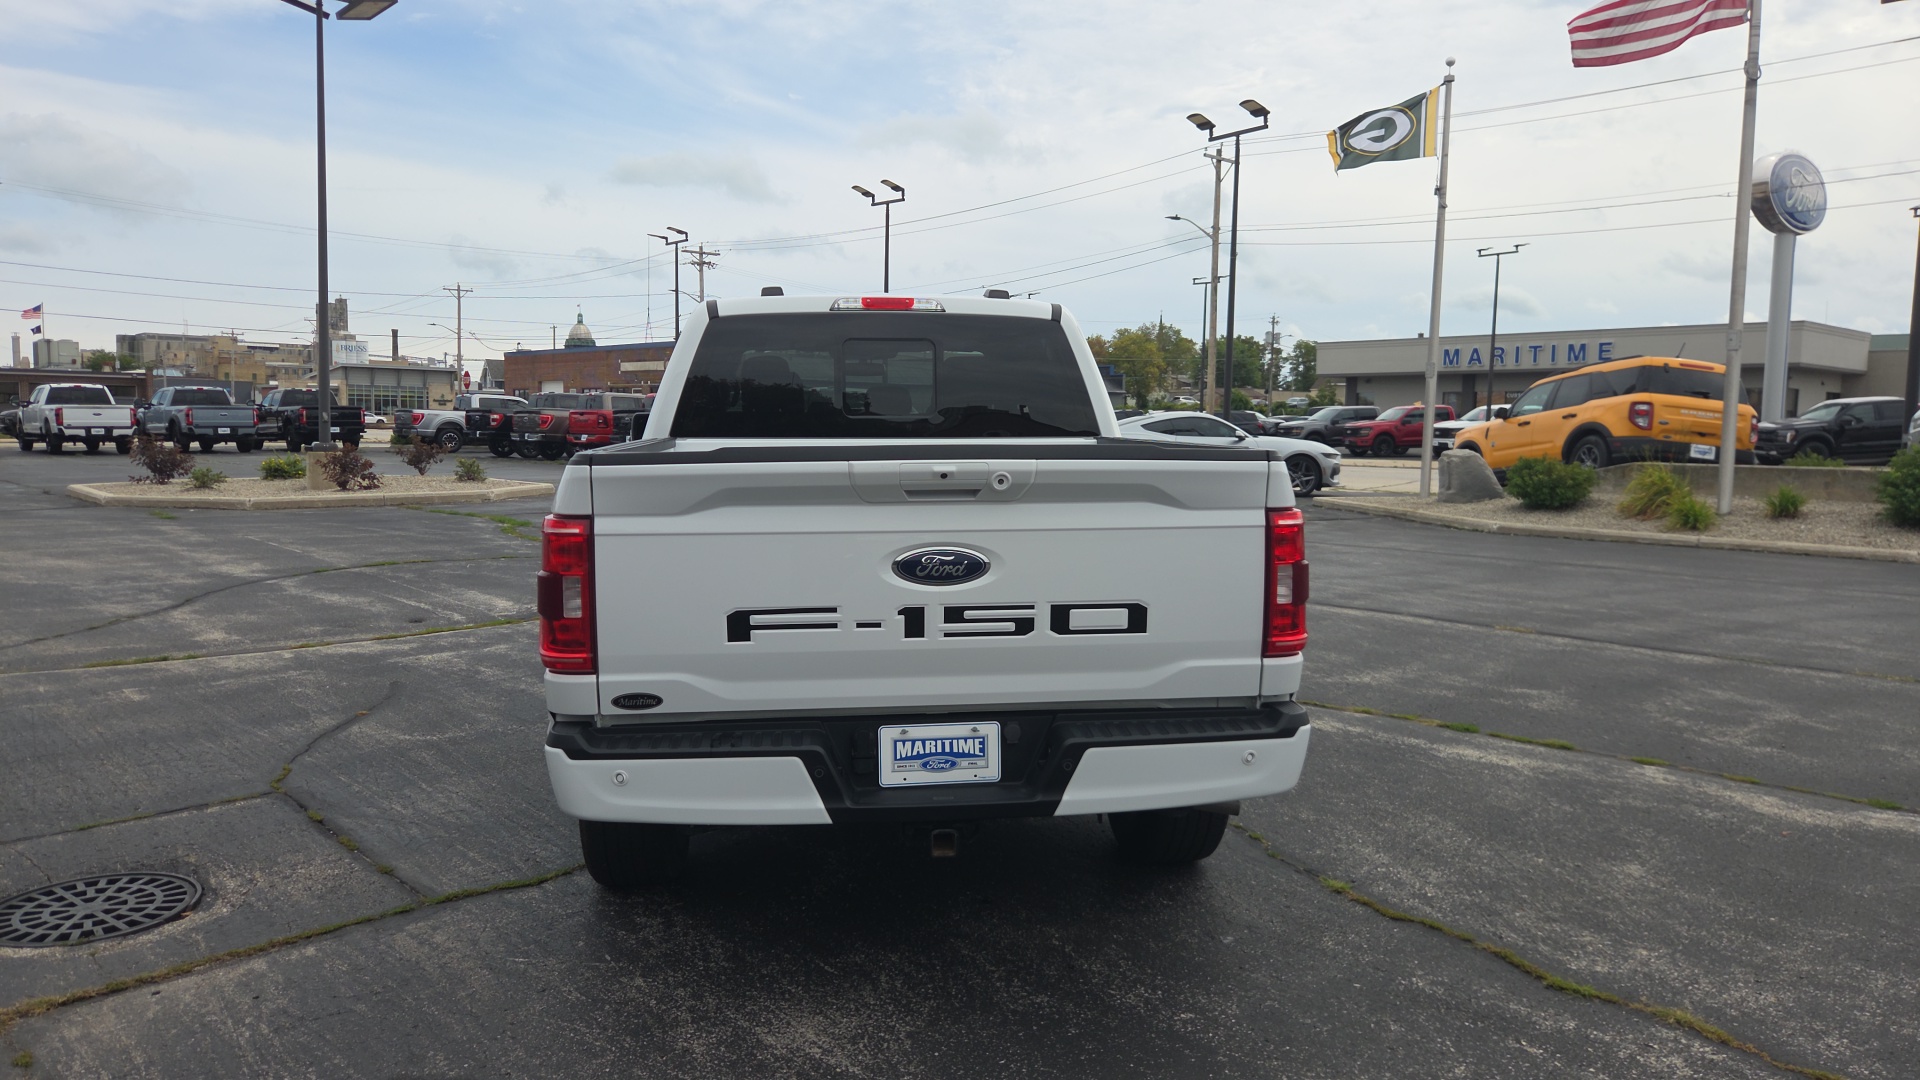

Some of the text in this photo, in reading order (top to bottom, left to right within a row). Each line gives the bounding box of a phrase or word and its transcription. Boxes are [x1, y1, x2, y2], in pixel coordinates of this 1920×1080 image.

[1785, 166, 1819, 217] Ford
[340, 344, 368, 352] BRIESS
[1442, 341, 1614, 368] MARITIME
[915, 554, 968, 578] Ford
[726, 602, 1148, 643] F-150
[618, 697, 658, 706] Maritime
[896, 738, 984, 760] MARITIME
[926, 759, 952, 770] Ford
